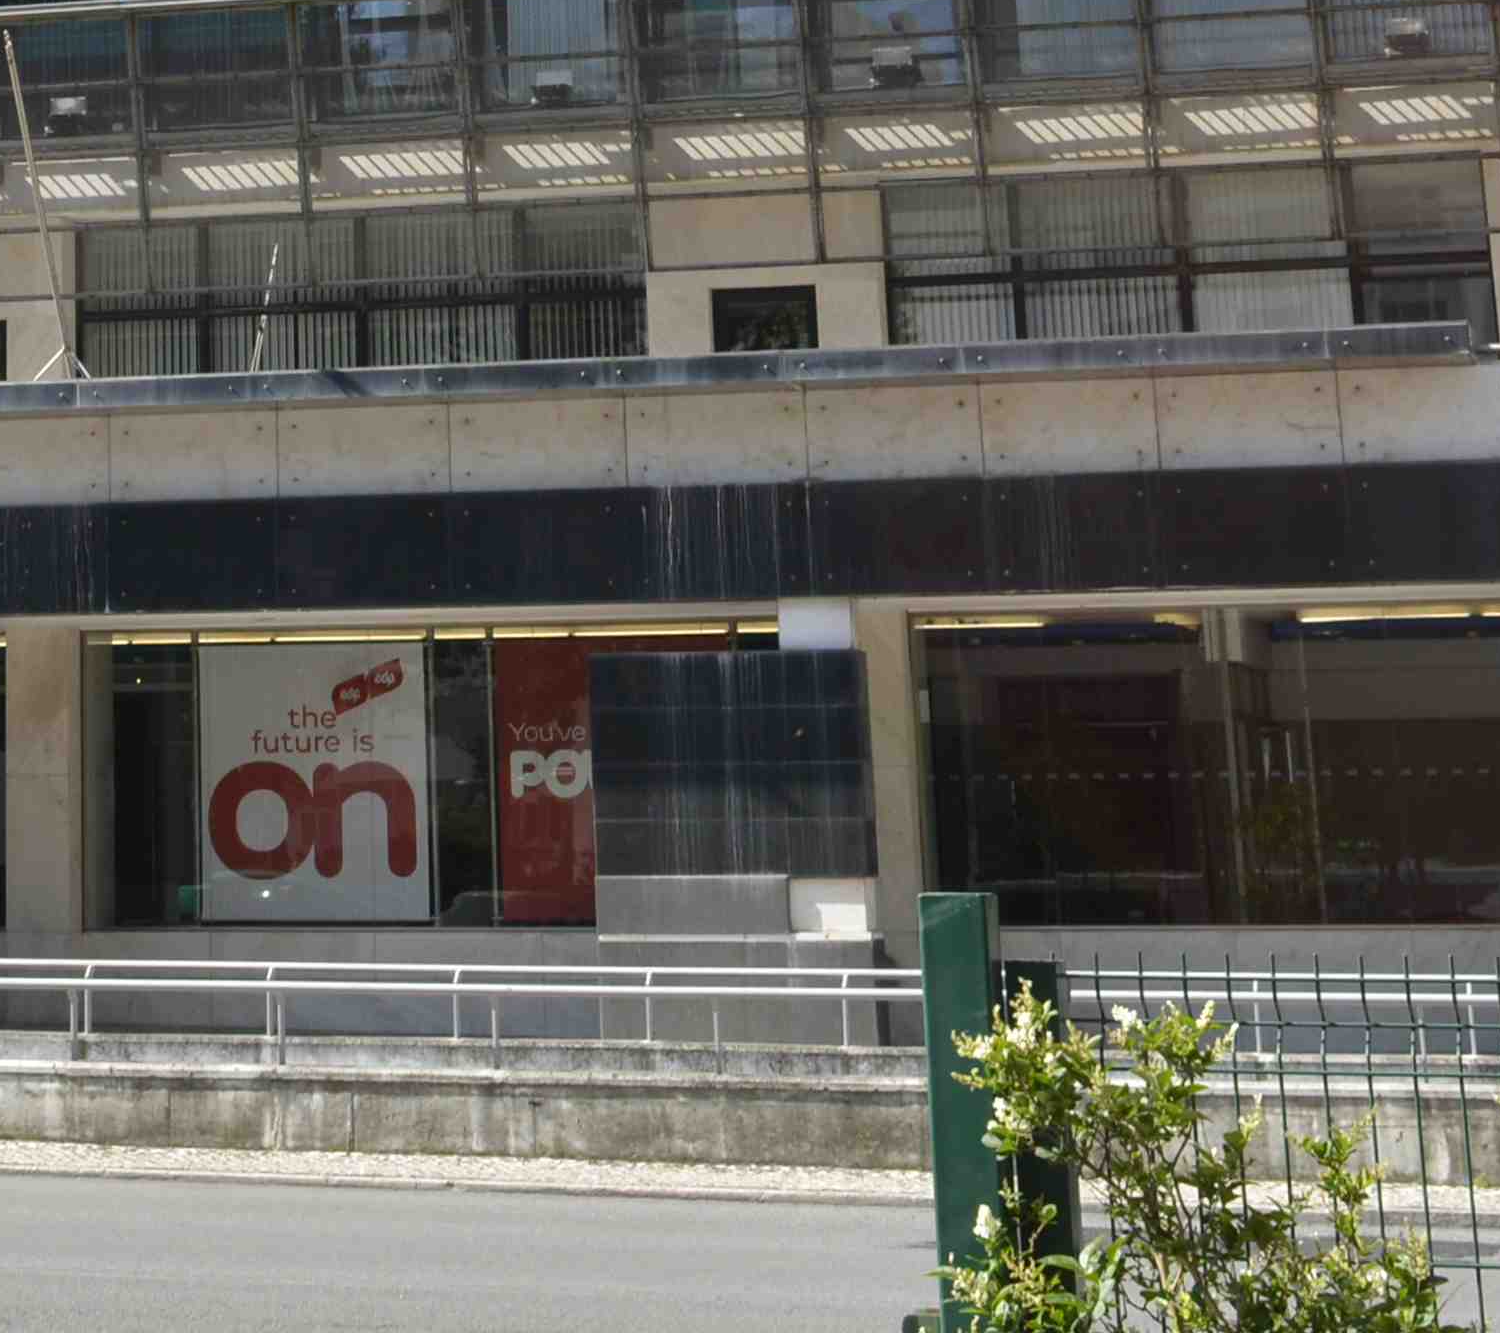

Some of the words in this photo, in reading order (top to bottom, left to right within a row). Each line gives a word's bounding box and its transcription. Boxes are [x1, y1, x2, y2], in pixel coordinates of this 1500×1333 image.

[287, 704, 338, 729] the
[251, 729, 341, 754] future
[352, 728, 376, 753] is
[508, 719, 587, 742] You've
[509, 749, 593, 799] PO
[207, 761, 418, 880] on
